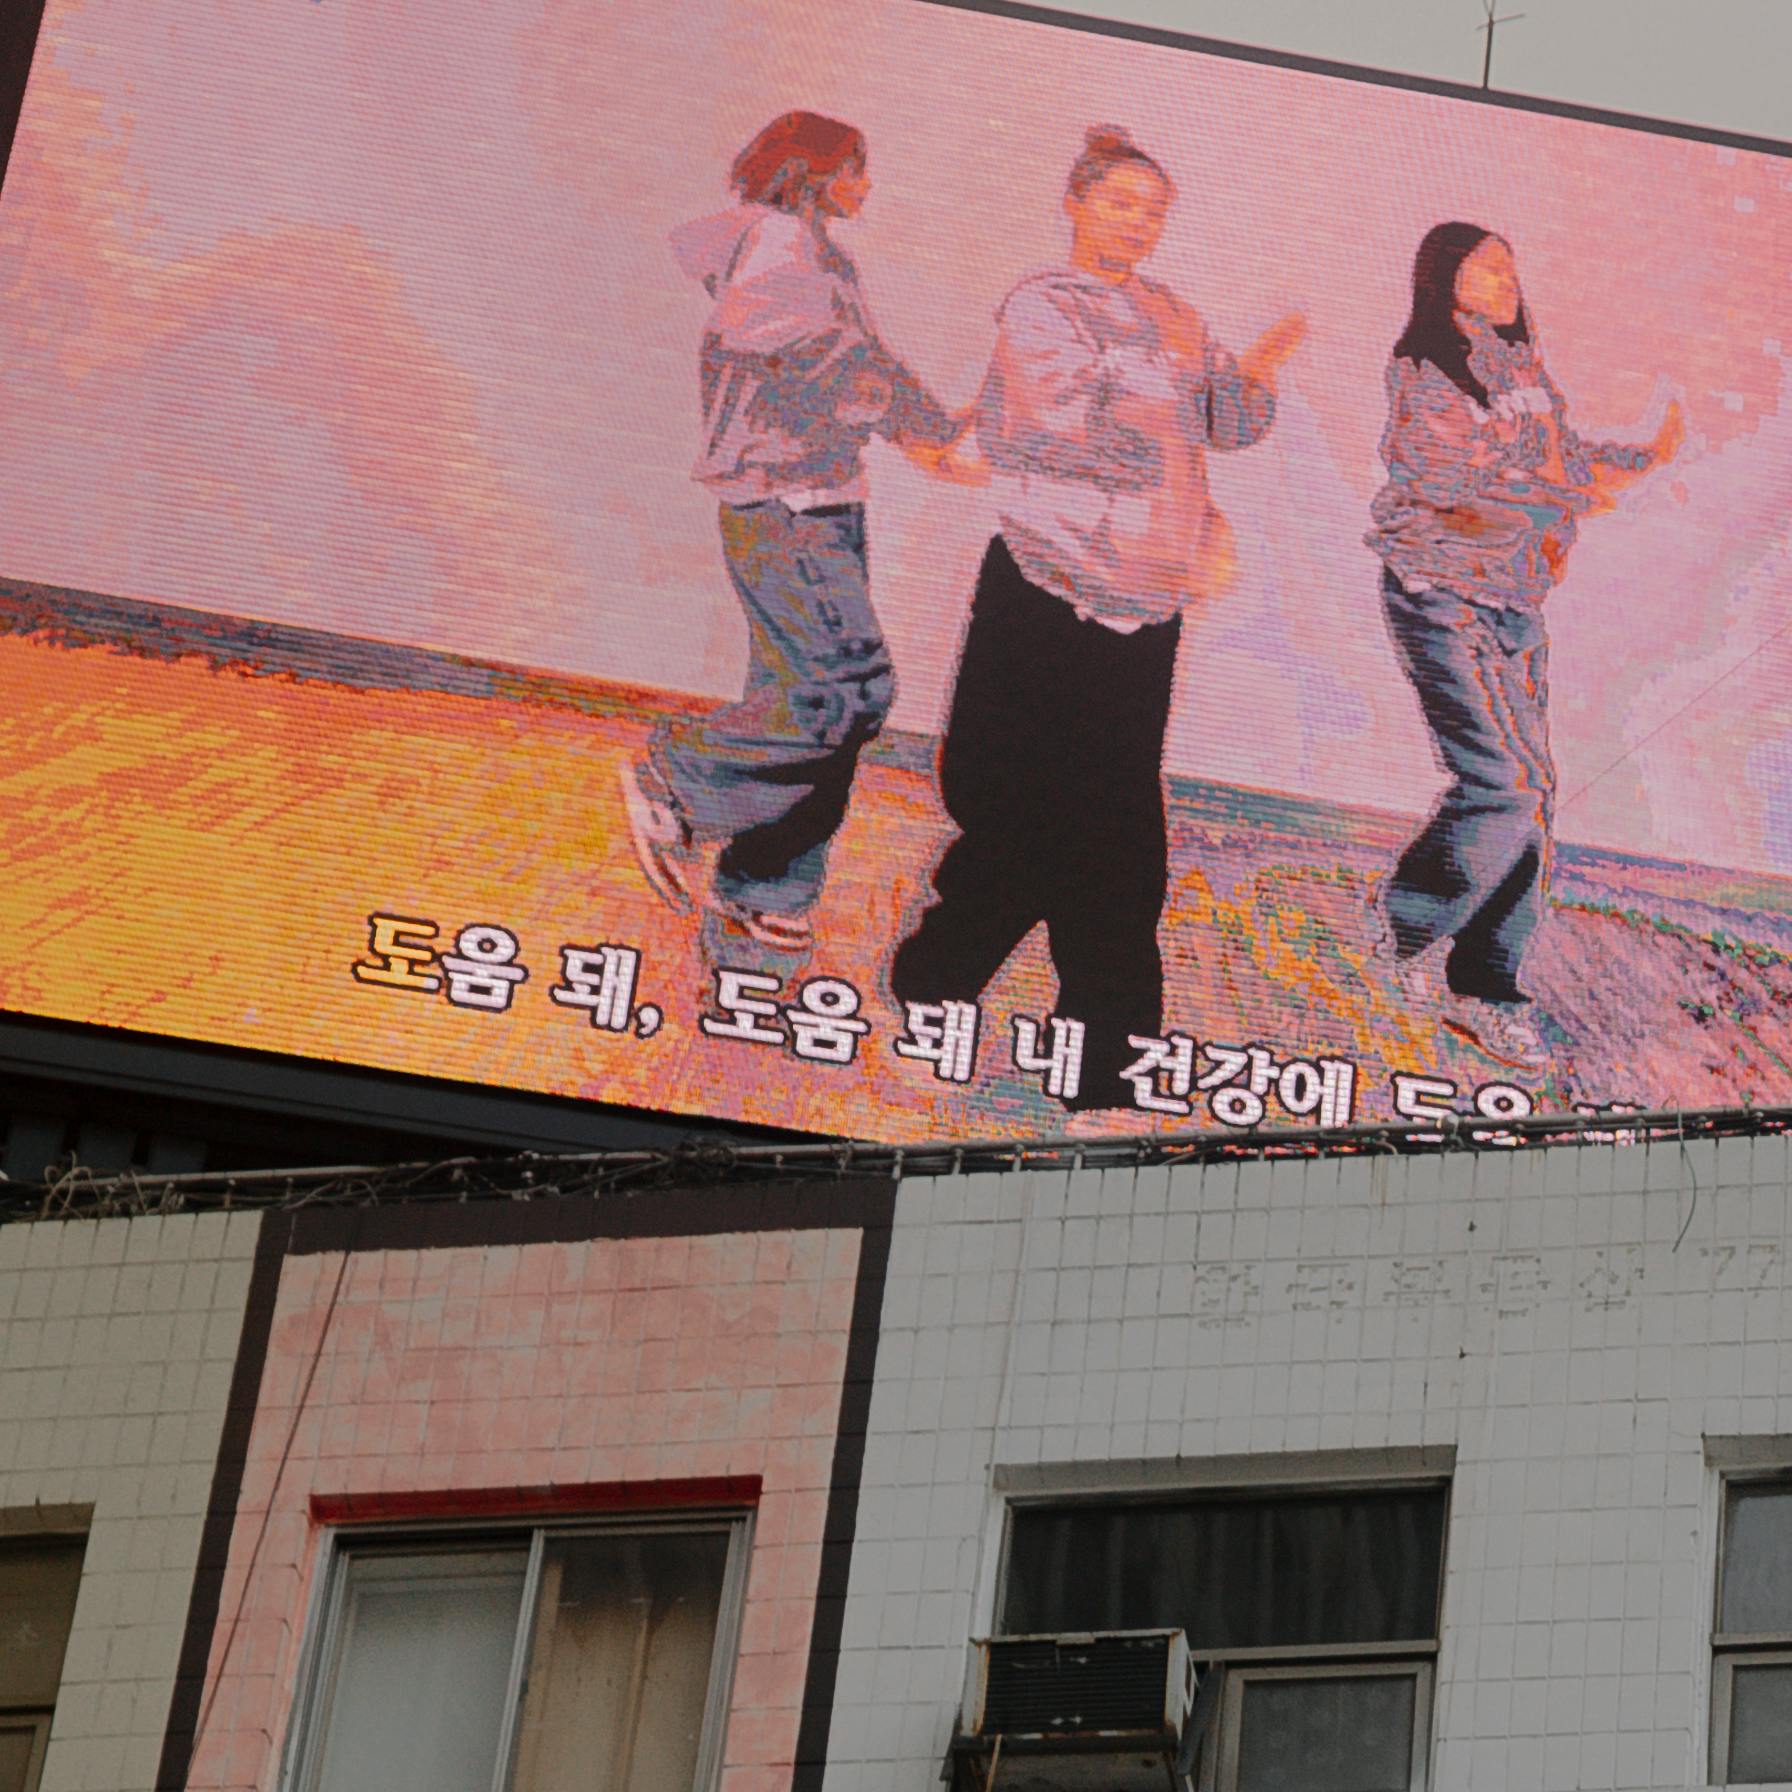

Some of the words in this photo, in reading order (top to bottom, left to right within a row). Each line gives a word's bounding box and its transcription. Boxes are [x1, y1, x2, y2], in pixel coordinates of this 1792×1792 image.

[352, 909, 528, 1012] 도움
[550, 944, 664, 1039] 돼,
[700, 965, 871, 1066] 도움
[895, 999, 981, 1083] 돼
[1012, 1015, 1086, 1100] 내
[1119, 1031, 1359, 1130] 건강에
